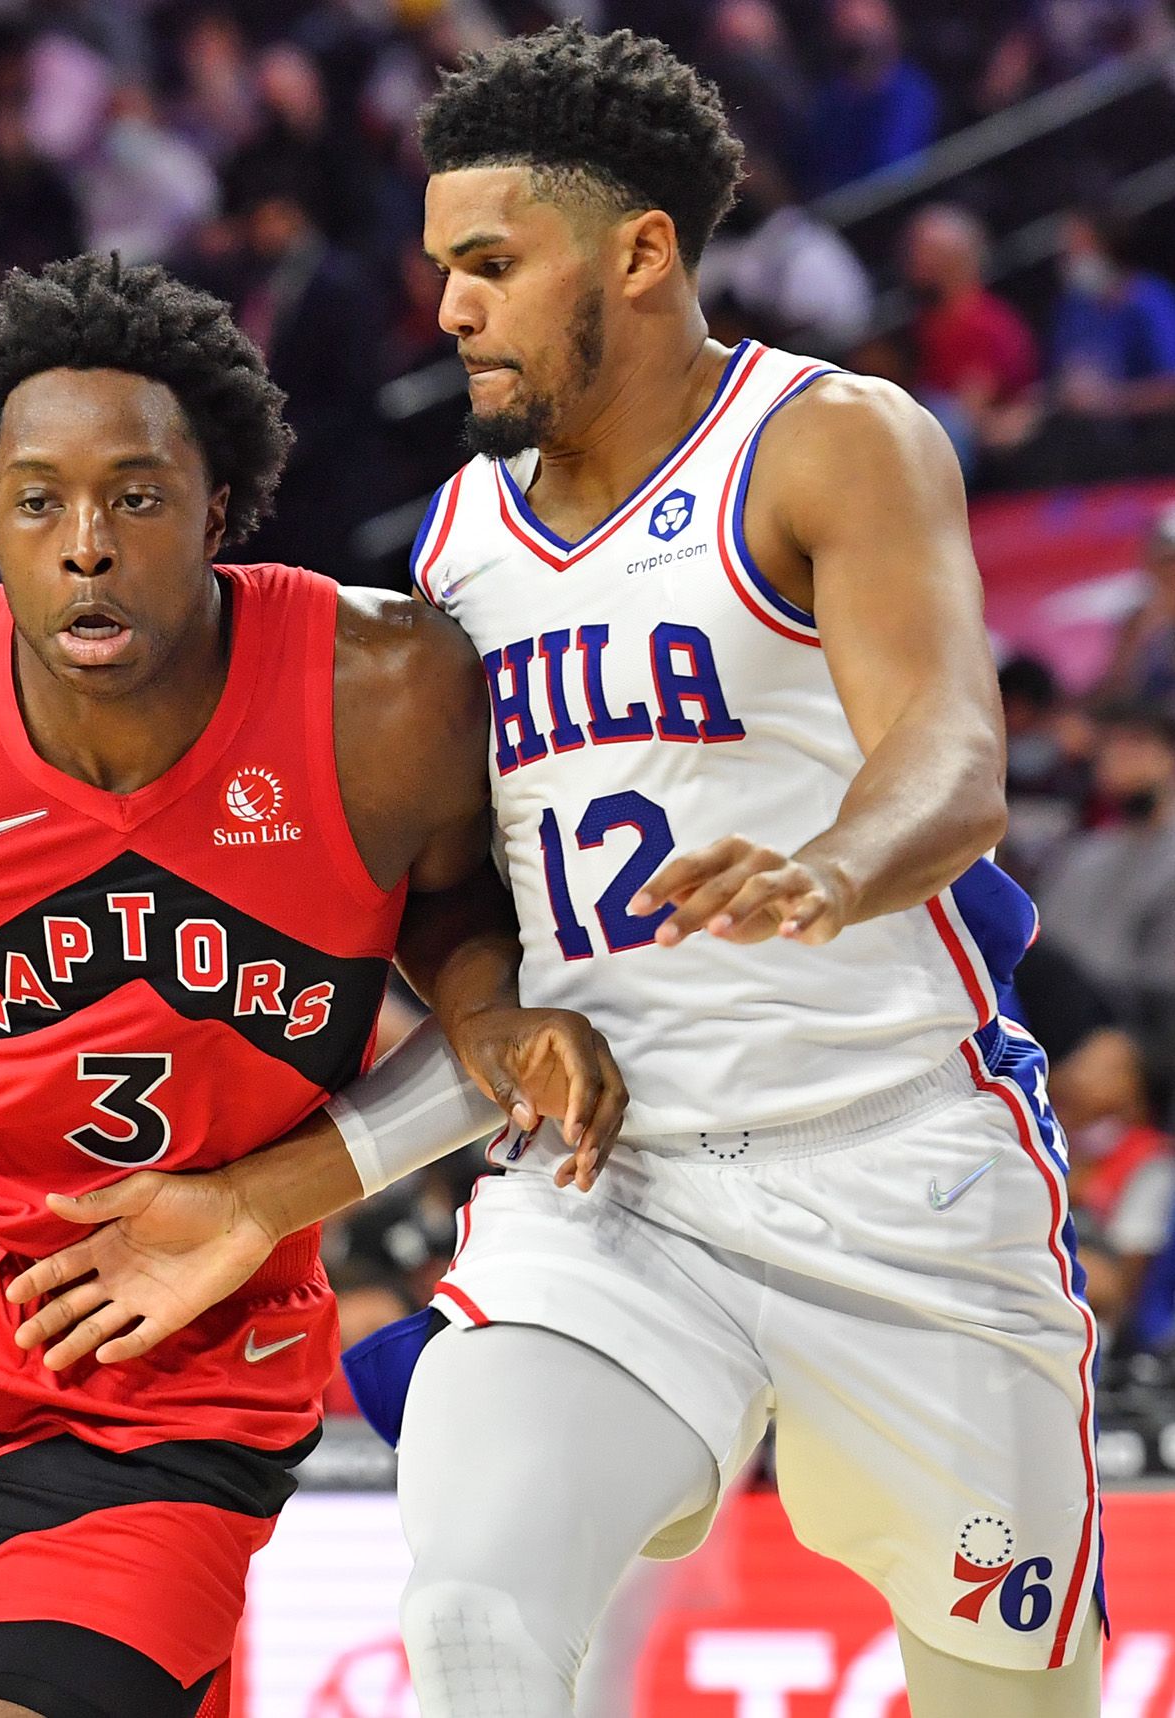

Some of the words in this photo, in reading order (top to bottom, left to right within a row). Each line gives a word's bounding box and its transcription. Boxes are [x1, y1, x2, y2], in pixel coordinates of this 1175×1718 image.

[626, 543, 708, 575] crypto.com
[482, 621, 746, 777] HILA
[213, 828, 256, 846] Sun
[260, 821, 302, 843] Life
[539, 789, 677, 962] 12
[64, 1052, 173, 1169] 3
[949, 1551, 1053, 1632] 76
